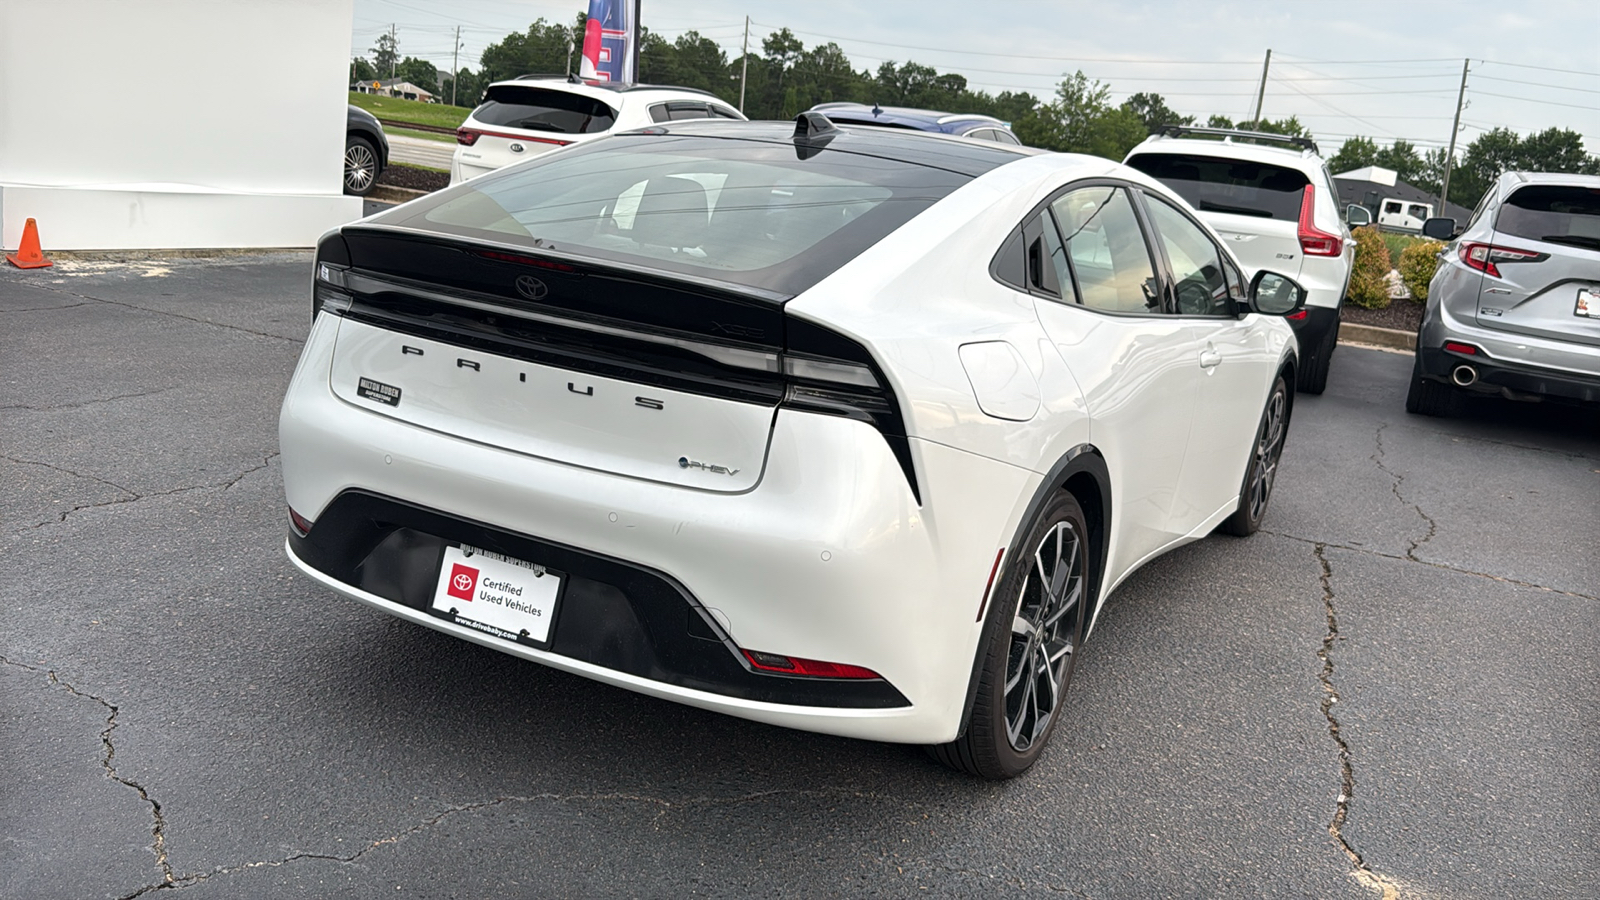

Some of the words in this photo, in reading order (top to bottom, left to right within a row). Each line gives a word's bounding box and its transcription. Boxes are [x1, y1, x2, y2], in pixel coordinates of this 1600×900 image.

[360, 379, 380, 392] MILTON
[380, 385, 399, 398] RUBEN
[402, 345, 664, 410] PRIUS
[483, 577, 523, 596] Certified
[480, 590, 503, 605] Used
[505, 597, 542, 617] Vehicles
[455, 616, 518, 640] www.drivebaby.com
